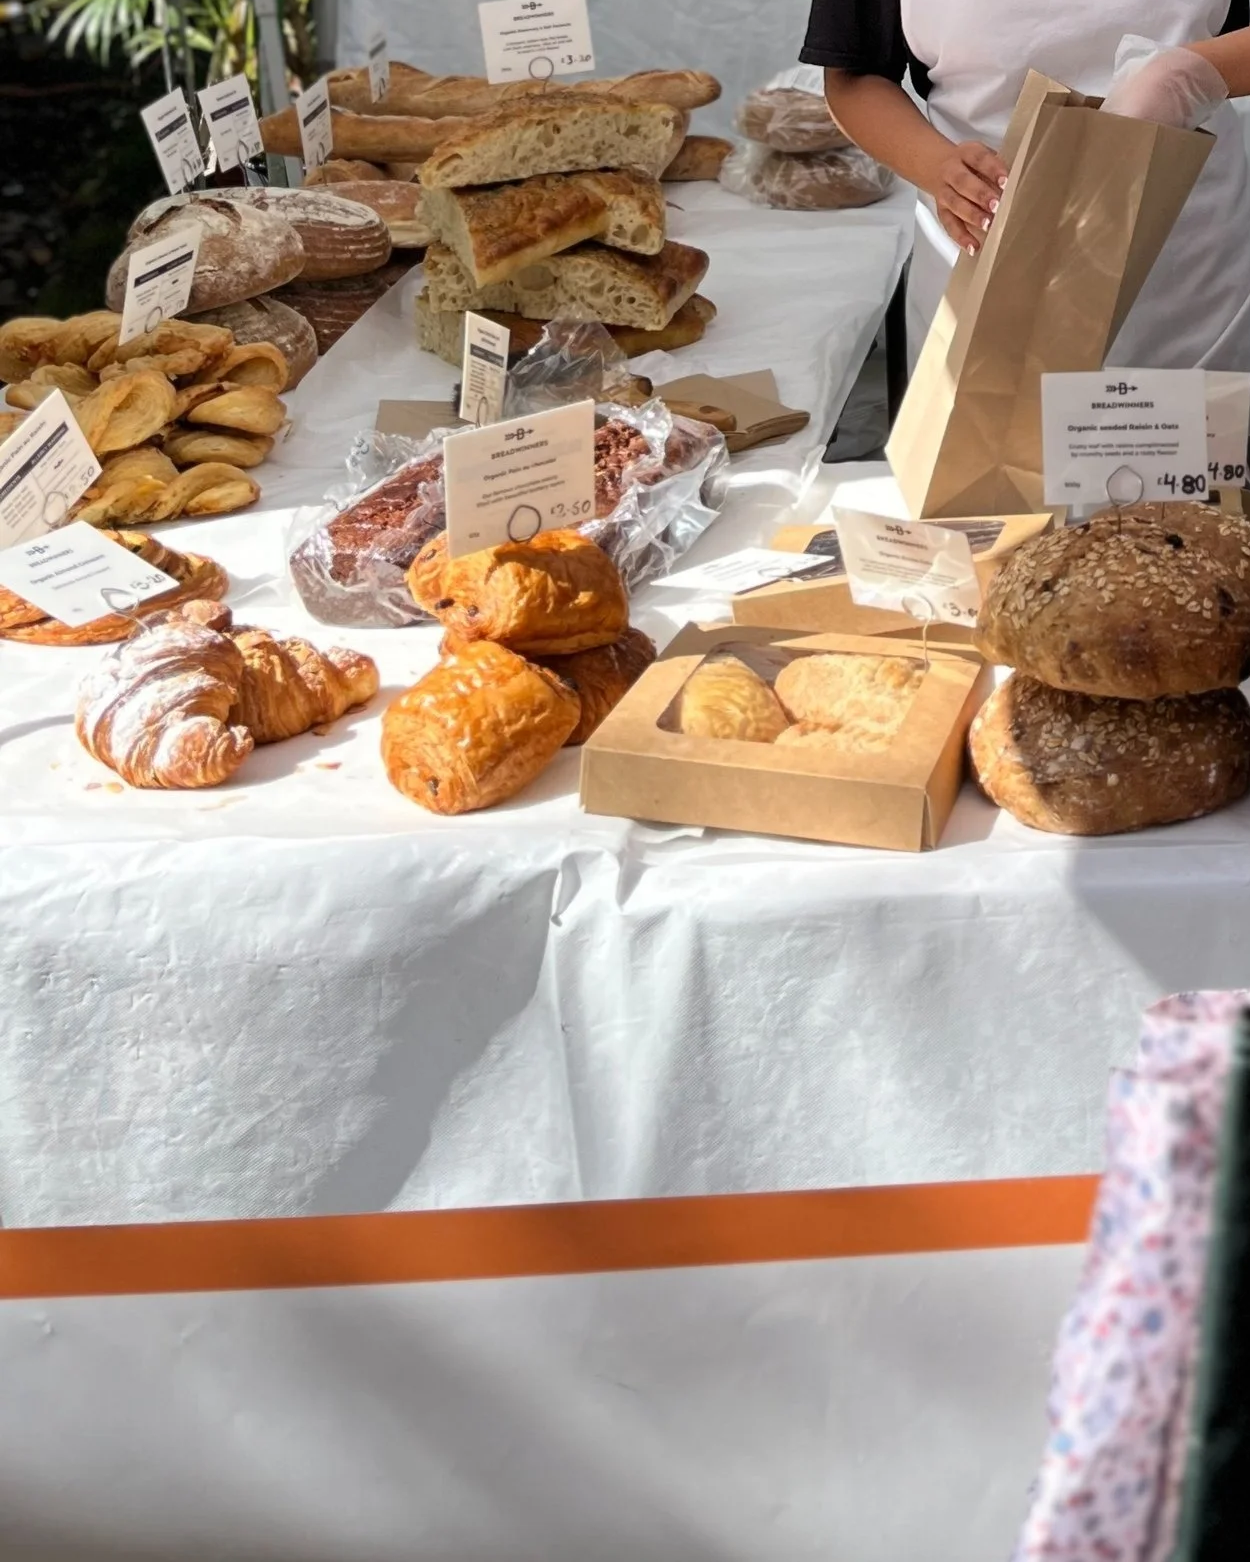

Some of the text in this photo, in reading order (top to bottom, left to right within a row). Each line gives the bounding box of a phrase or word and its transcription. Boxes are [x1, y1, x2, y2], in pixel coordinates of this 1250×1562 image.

[1091, 401, 1154, 410] BREADWINNERS
[1067, 424, 1098, 433] Organic
[491, 439, 549, 460] BREADWINNERS
